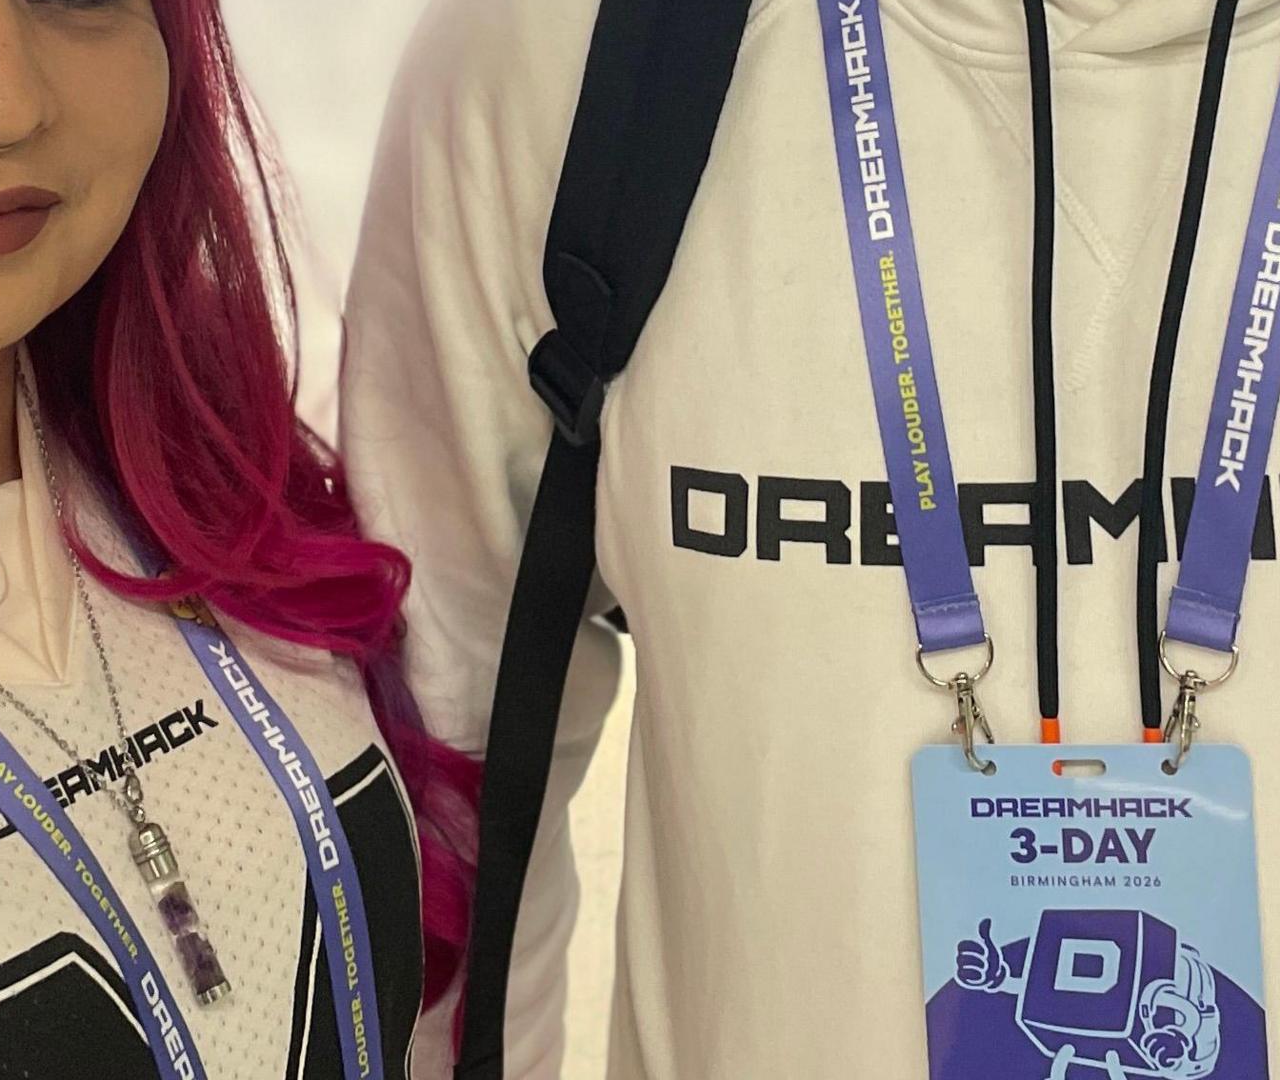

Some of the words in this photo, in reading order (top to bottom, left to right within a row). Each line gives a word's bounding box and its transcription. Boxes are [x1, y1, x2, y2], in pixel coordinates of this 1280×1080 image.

[879, 250, 909, 364] TOGETHER.
[898, 367, 926, 455] LOUDER.
[913, 460, 936, 511] PLAY
[209, 640, 339, 871] DREAMHACK
[970, 798, 1192, 818] DREAMHACK
[1010, 827, 1156, 864] 3-DAY
[14, 784, 71, 860] LOUDER.
[75, 859, 138, 964] TOGETHER.
[1010, 875, 1116, 887] BIRMINGHAM
[1124, 875, 1161, 887] 2026
[332, 878, 358, 990] TOGETHER.
[352, 991, 370, 1078] LOUDER.
